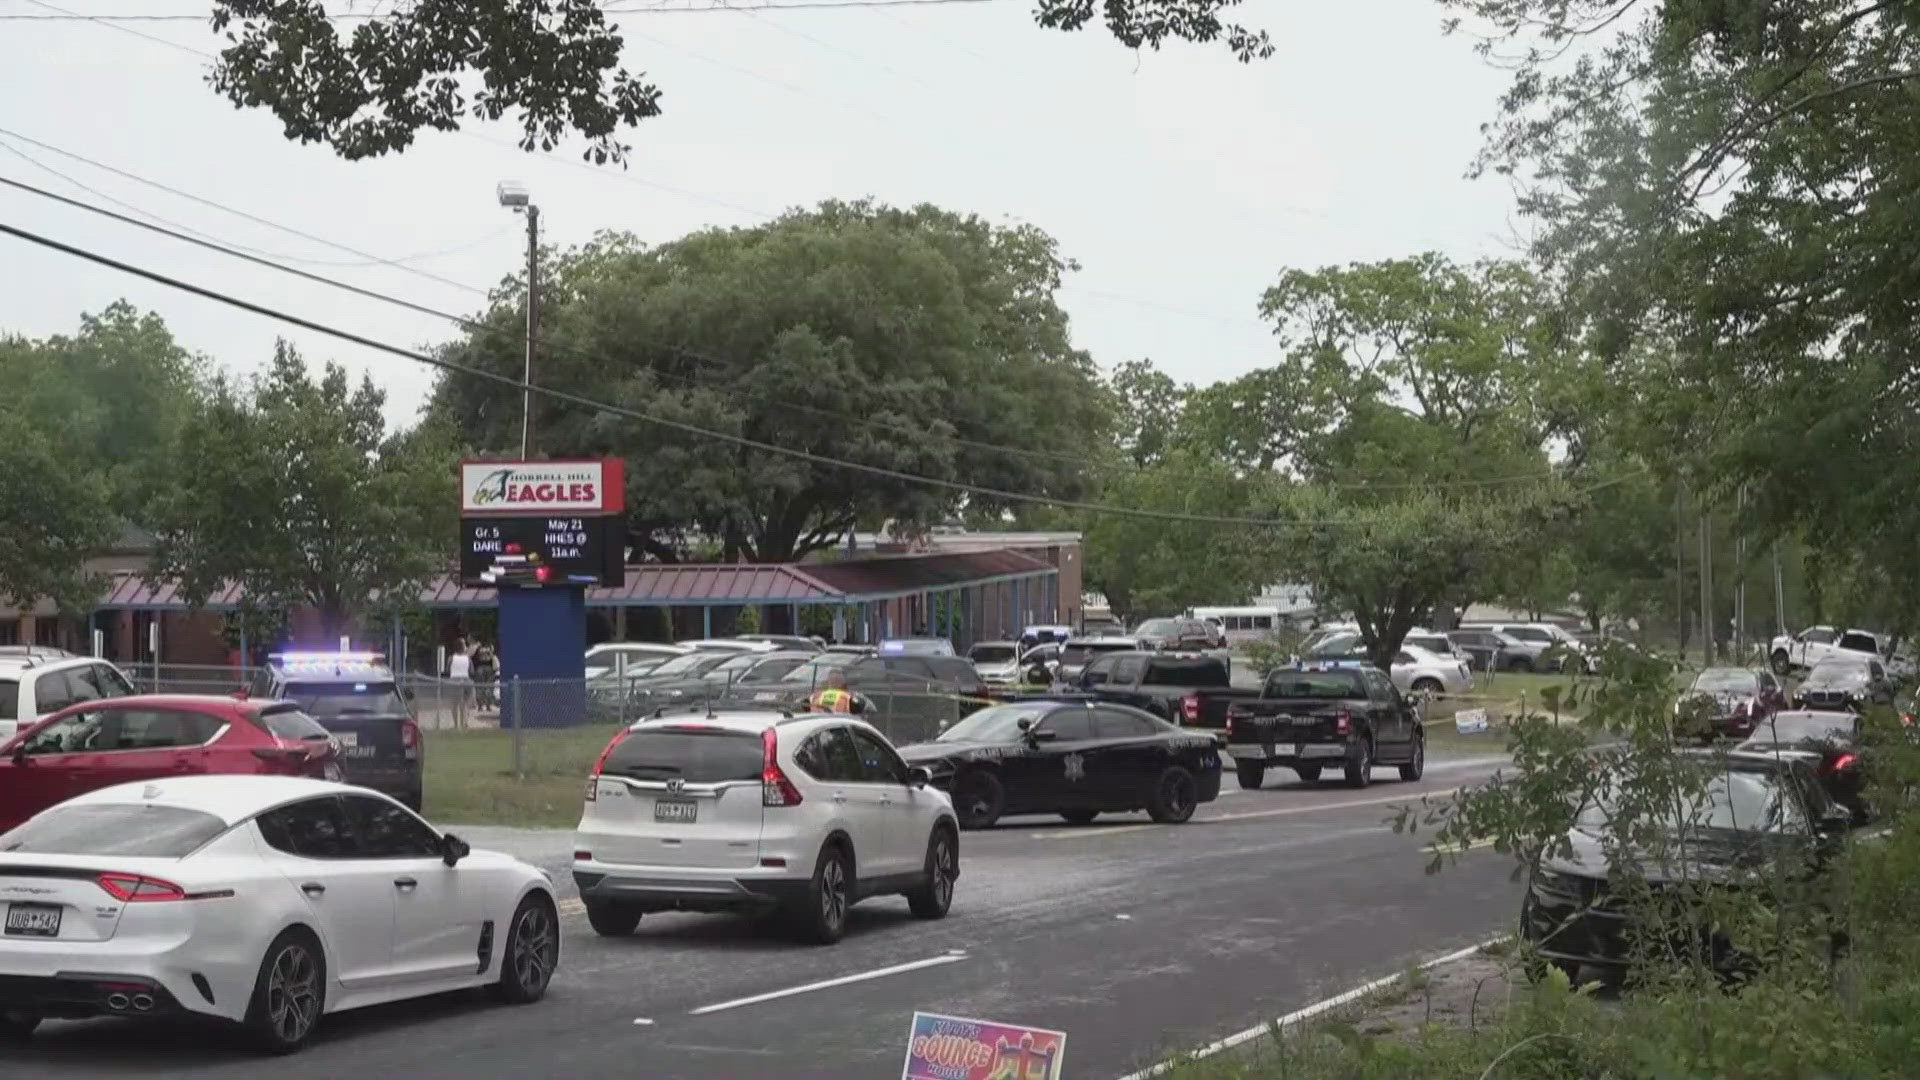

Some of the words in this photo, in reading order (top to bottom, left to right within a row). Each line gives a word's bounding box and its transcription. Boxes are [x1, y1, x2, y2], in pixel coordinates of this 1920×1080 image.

[567, 473, 592, 482] HILL
[506, 483, 596, 502] EAGLES
[548, 519, 569, 532] May
[571, 519, 582, 530] 21
[475, 527, 491, 539] Gr.
[493, 527, 500, 538] 5
[545, 532, 574, 544] HHES
[576, 532, 587, 546] @
[473, 541, 501, 552] DARE
[39, 912, 57, 929] 542
[912, 1033, 994, 1069] BOUNCE
